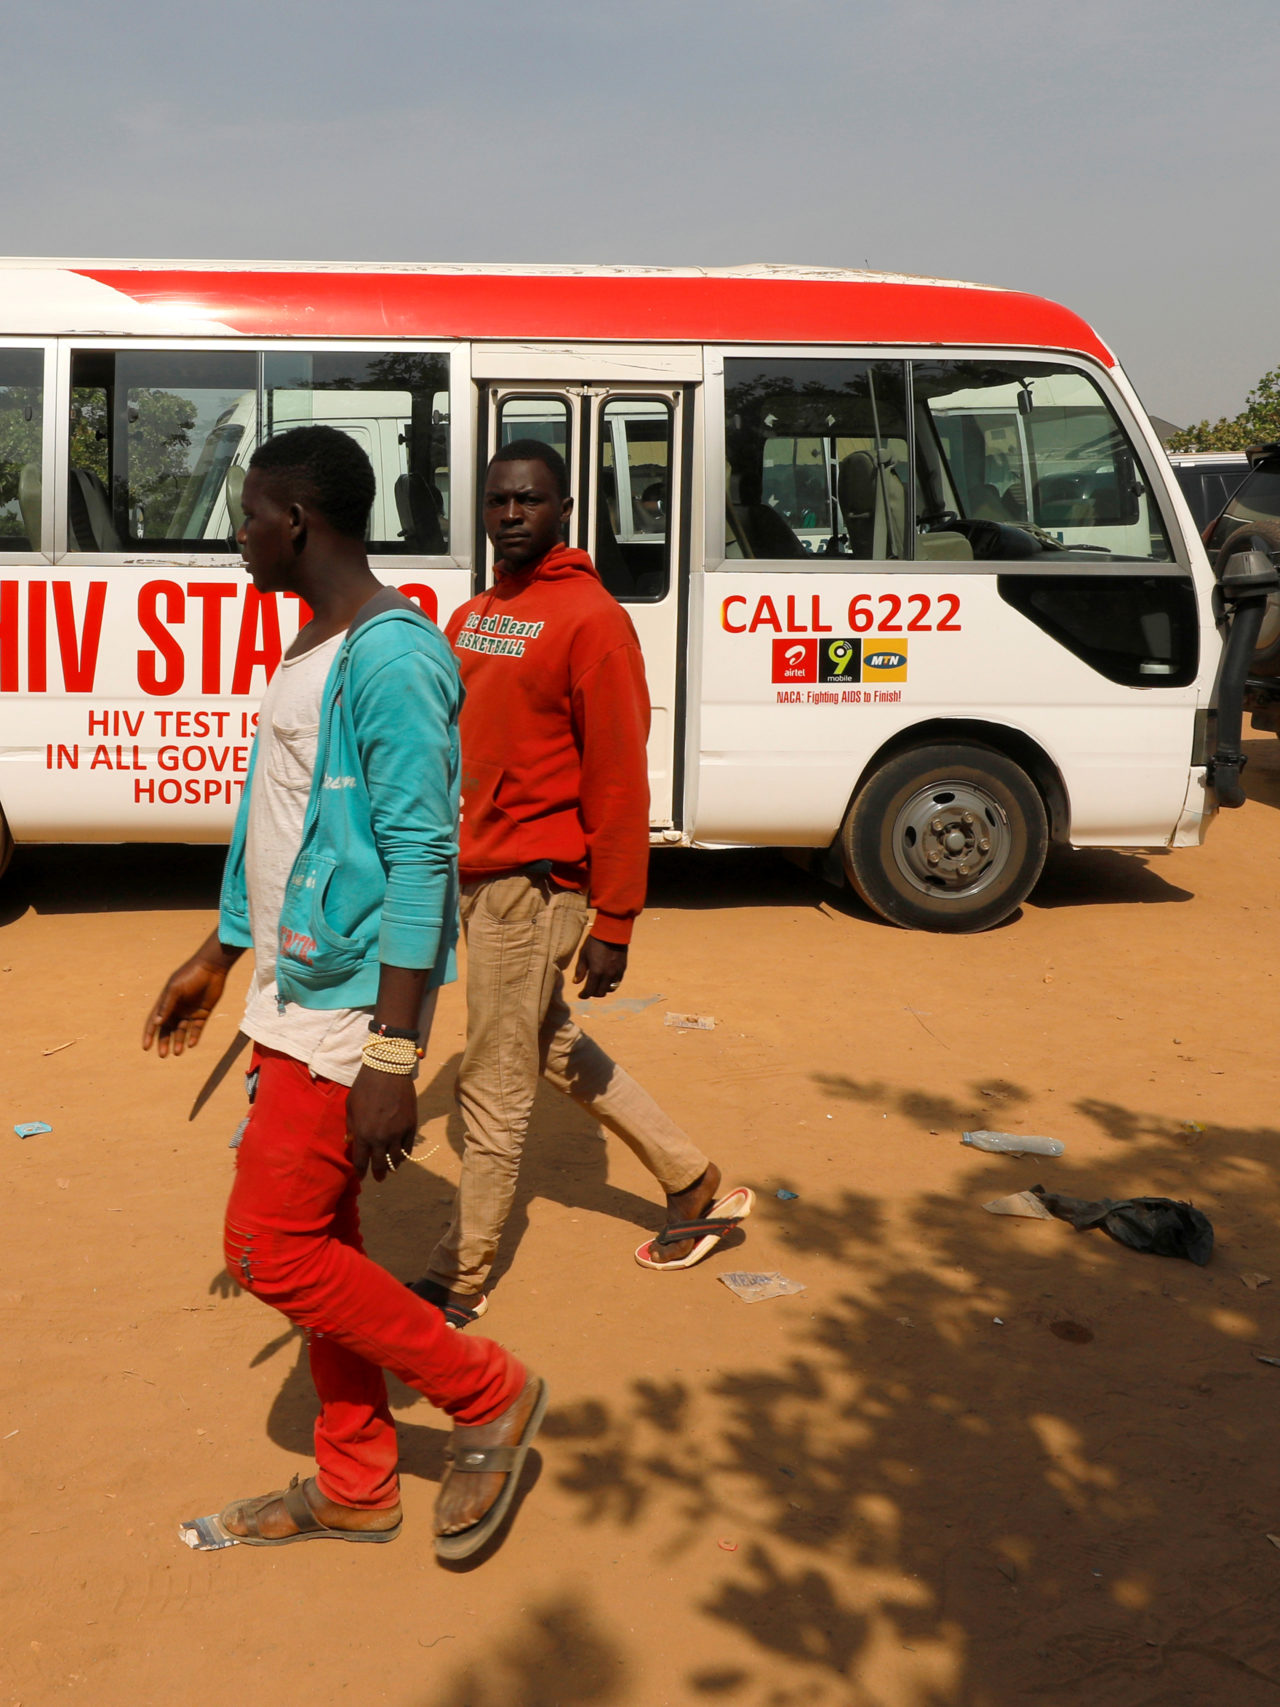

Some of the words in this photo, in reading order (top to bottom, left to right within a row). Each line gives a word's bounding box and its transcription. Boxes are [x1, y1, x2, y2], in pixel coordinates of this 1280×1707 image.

[720, 594, 833, 634] CALL
[847, 593, 962, 633] 6222
[137, 579, 438, 696] STA
[497, 615, 545, 639] Heart
[828, 640, 853, 675] 9
[870, 655, 900, 666] MTN
[784, 668, 806, 677] airtel
[776, 690, 804, 704] NACA:
[807, 690, 839, 705] Fighting
[841, 690, 861, 703] AIDS
[863, 691, 871, 703] to
[874, 689, 902, 703] Finish!
[88, 710, 145, 737] HIV
[154, 711, 230, 738] TEST
[46, 744, 79, 769] IN
[90, 745, 147, 770] ALL
